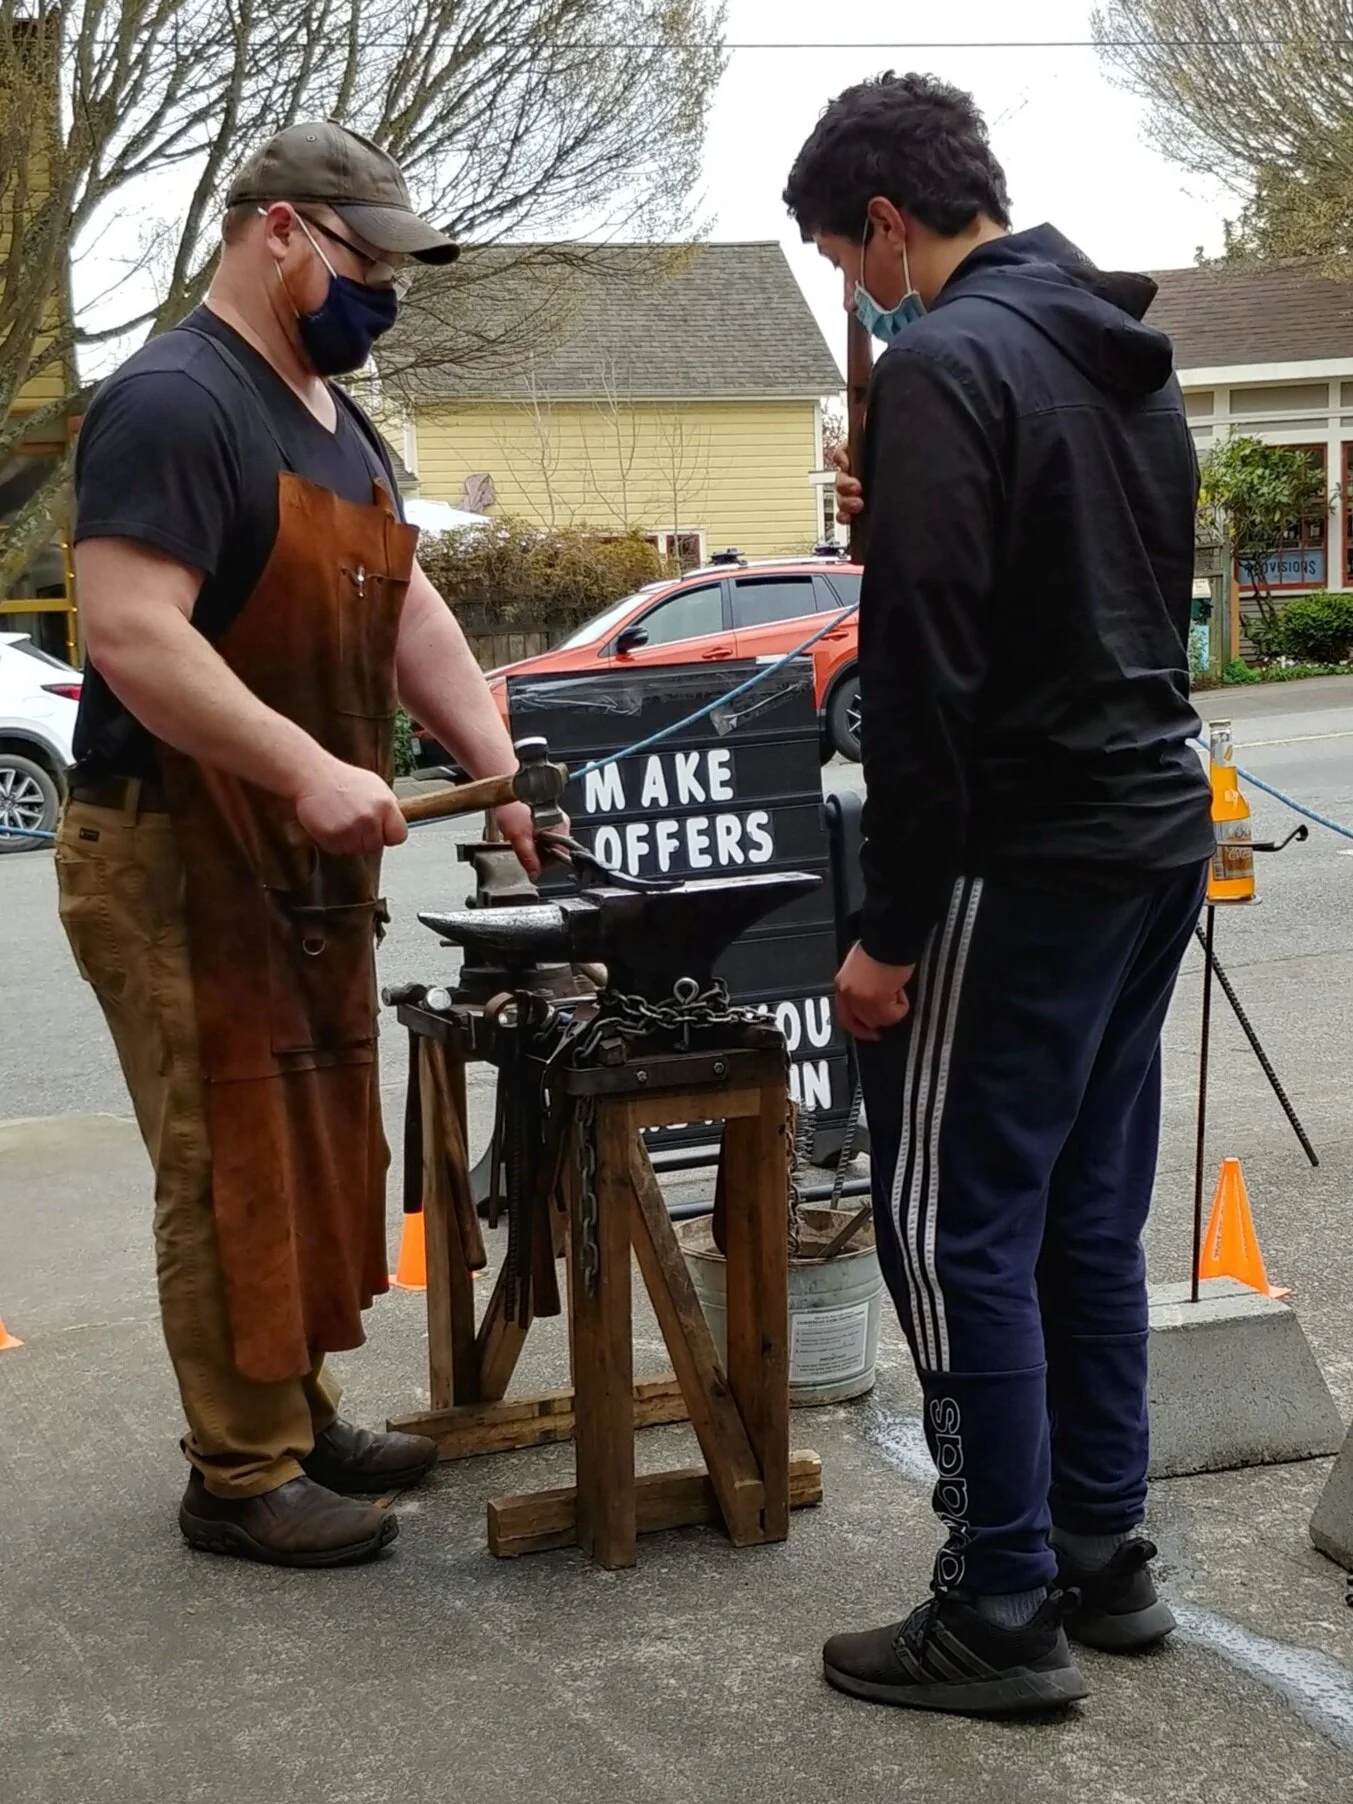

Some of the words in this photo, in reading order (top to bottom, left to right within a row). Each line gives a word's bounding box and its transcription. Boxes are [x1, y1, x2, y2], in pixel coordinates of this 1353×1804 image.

[1245, 559, 1317, 577] OVISIONS
[585, 749, 734, 813] MAKE
[594, 811, 773, 876] OFFERS
[746, 996, 832, 1052] OU
[930, 1397, 970, 1586] aidas
